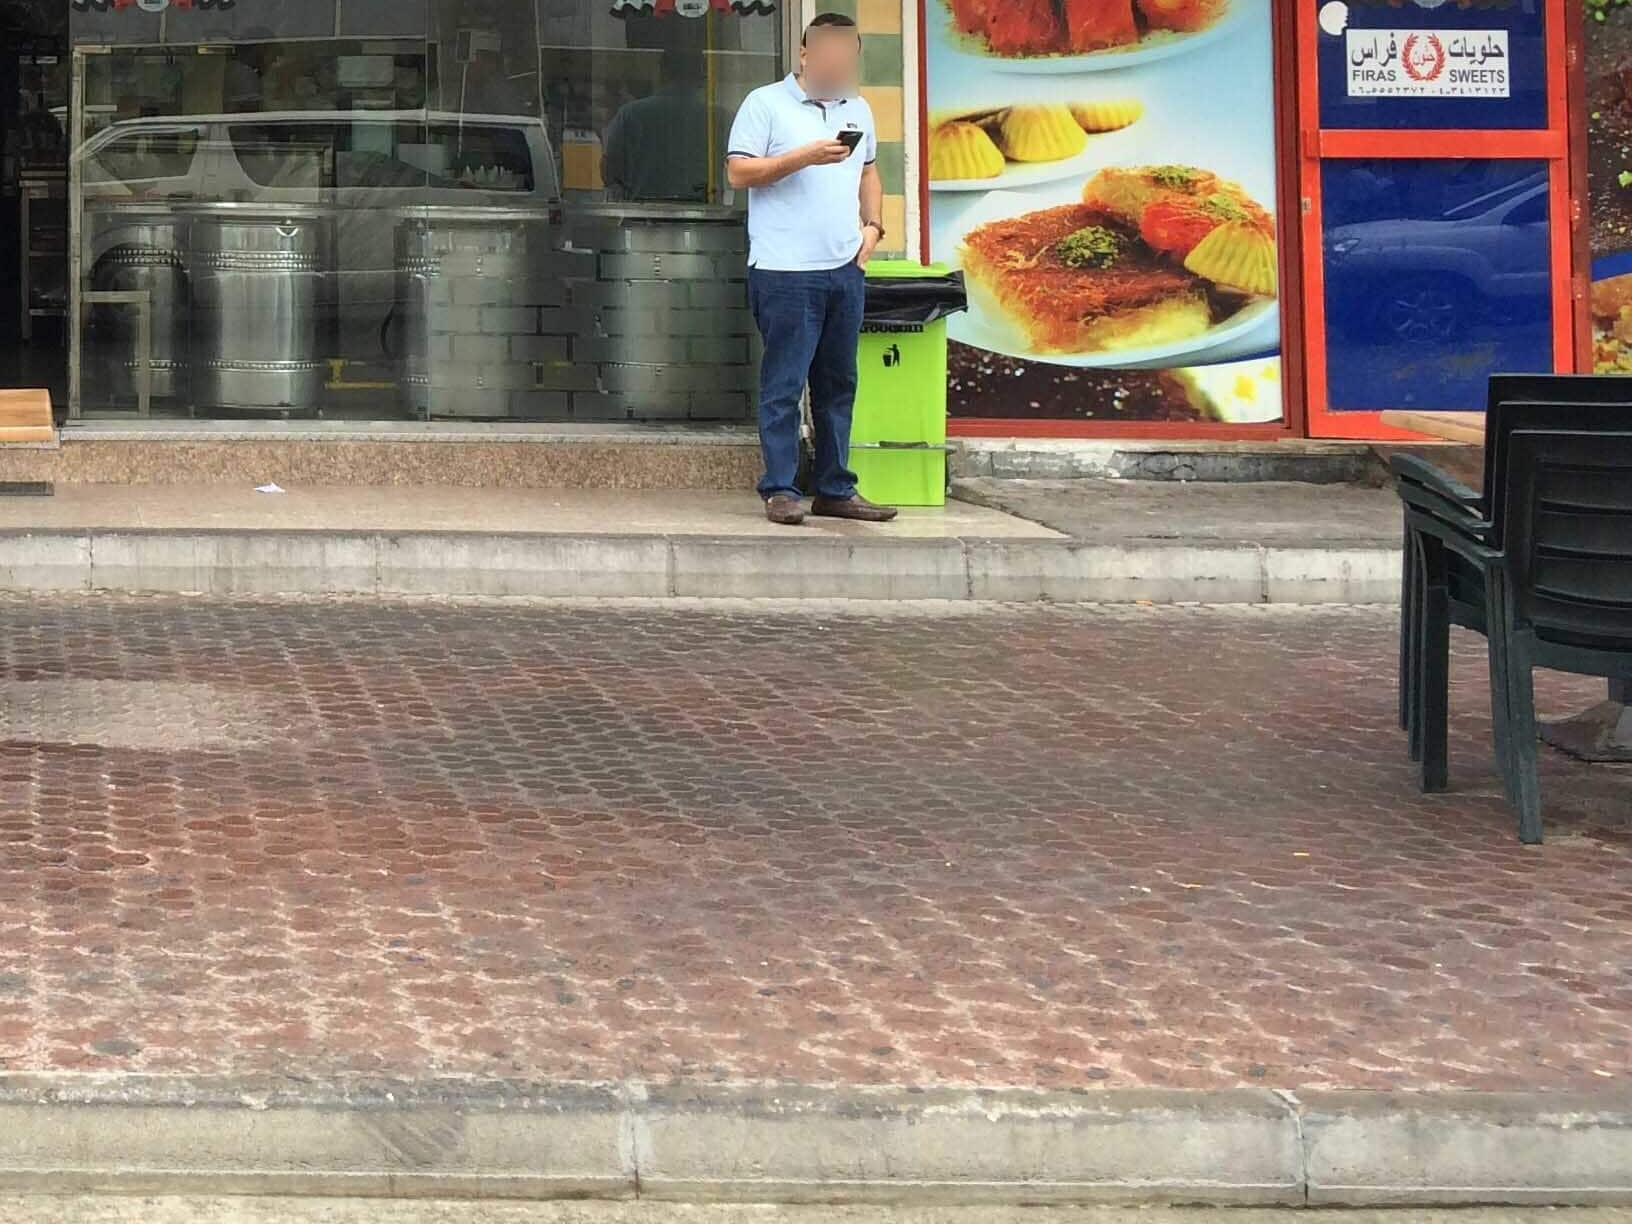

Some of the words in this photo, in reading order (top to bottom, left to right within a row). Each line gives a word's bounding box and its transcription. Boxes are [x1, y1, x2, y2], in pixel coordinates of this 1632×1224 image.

[1351, 32, 1397, 67] فراس
[1448, 34, 1505, 65] حلويات
[1352, 69, 1396, 82] FIRAS
[1449, 69, 1505, 84] SWEETS
